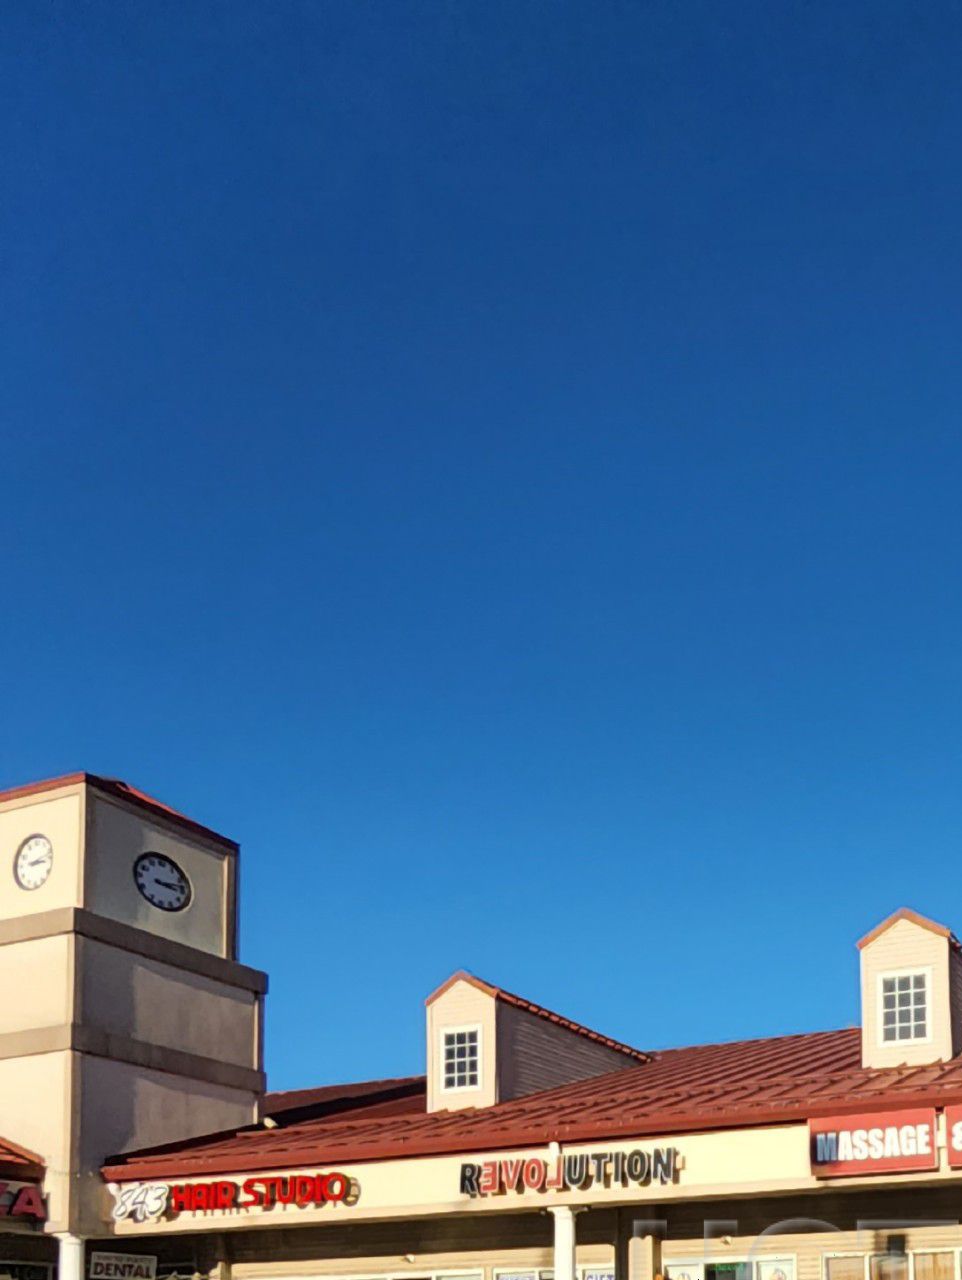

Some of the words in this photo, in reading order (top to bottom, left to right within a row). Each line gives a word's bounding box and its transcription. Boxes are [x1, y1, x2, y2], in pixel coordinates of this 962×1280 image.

[815, 1124, 932, 1161] MASSAGE
[460, 1147, 676, 1195] REVOLUTION
[112, 1183, 169, 1221] 843
[172, 1181, 235, 1212] HAIR
[243, 1172, 350, 1207] STUDIO
[93, 1262, 152, 1279] DENTAL
